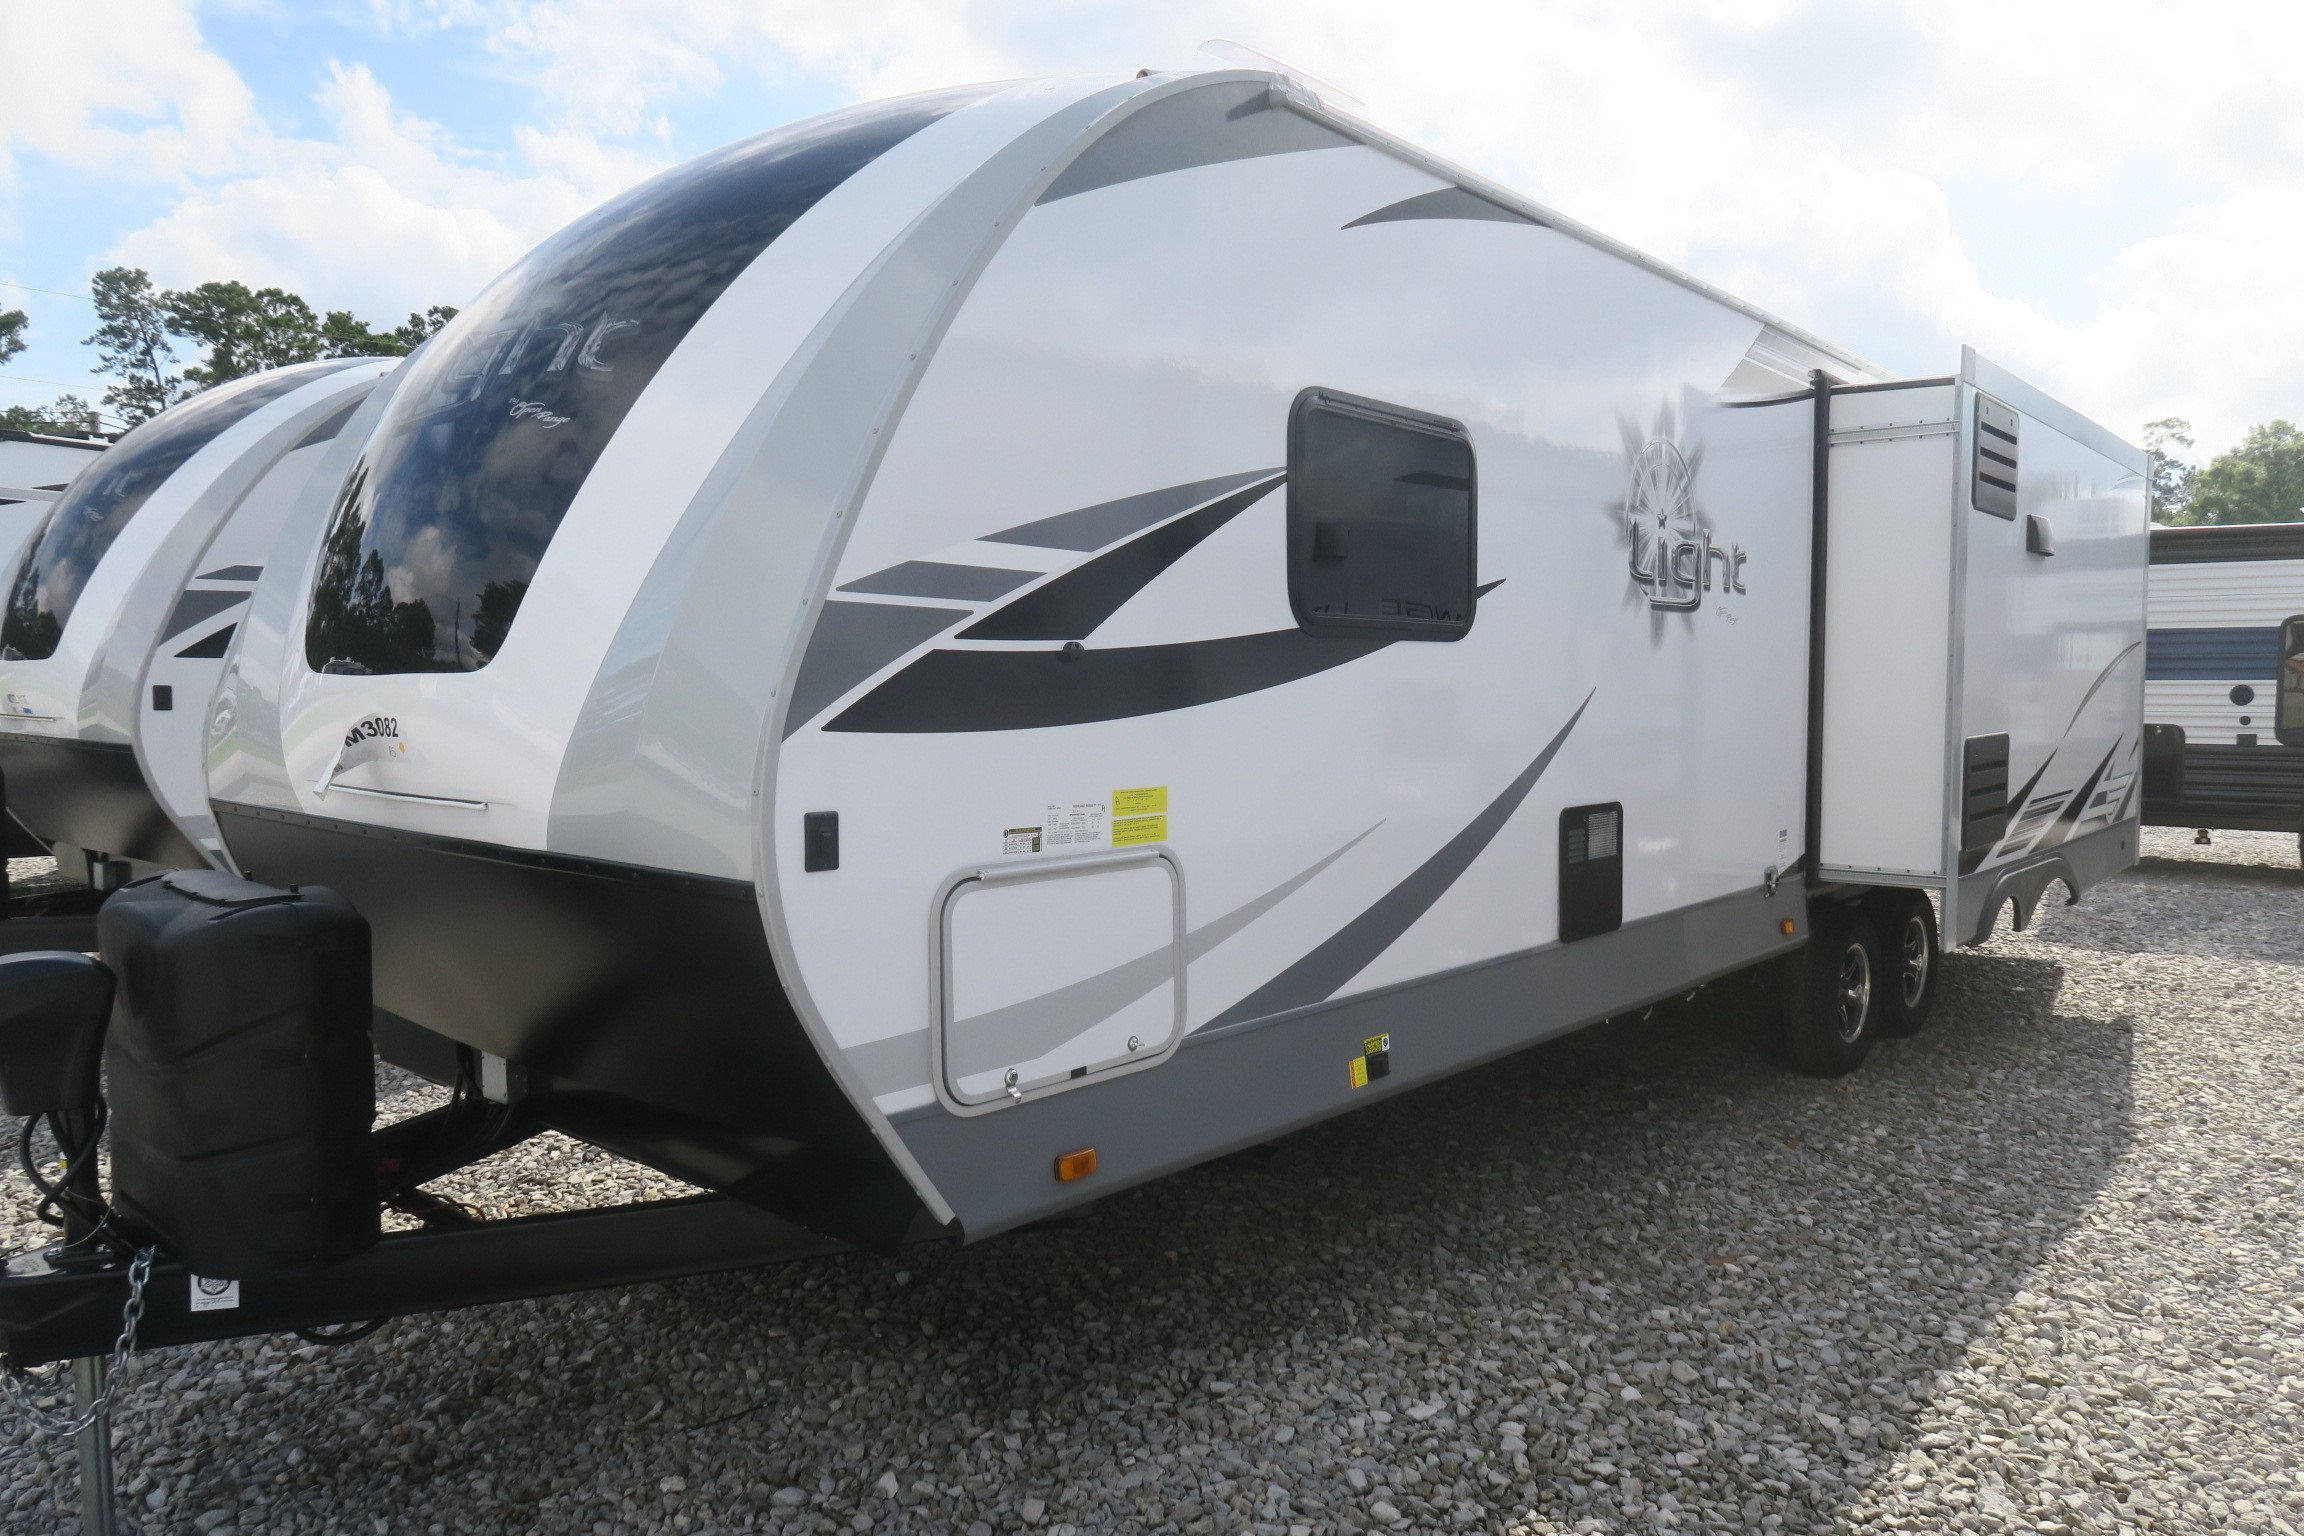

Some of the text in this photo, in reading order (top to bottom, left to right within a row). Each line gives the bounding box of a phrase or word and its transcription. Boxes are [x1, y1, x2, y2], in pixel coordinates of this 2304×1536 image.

[510, 401, 546, 419] Open
[530, 411, 571, 428] Range
[1628, 517, 1747, 608] Light
[344, 717, 399, 748] M3082
